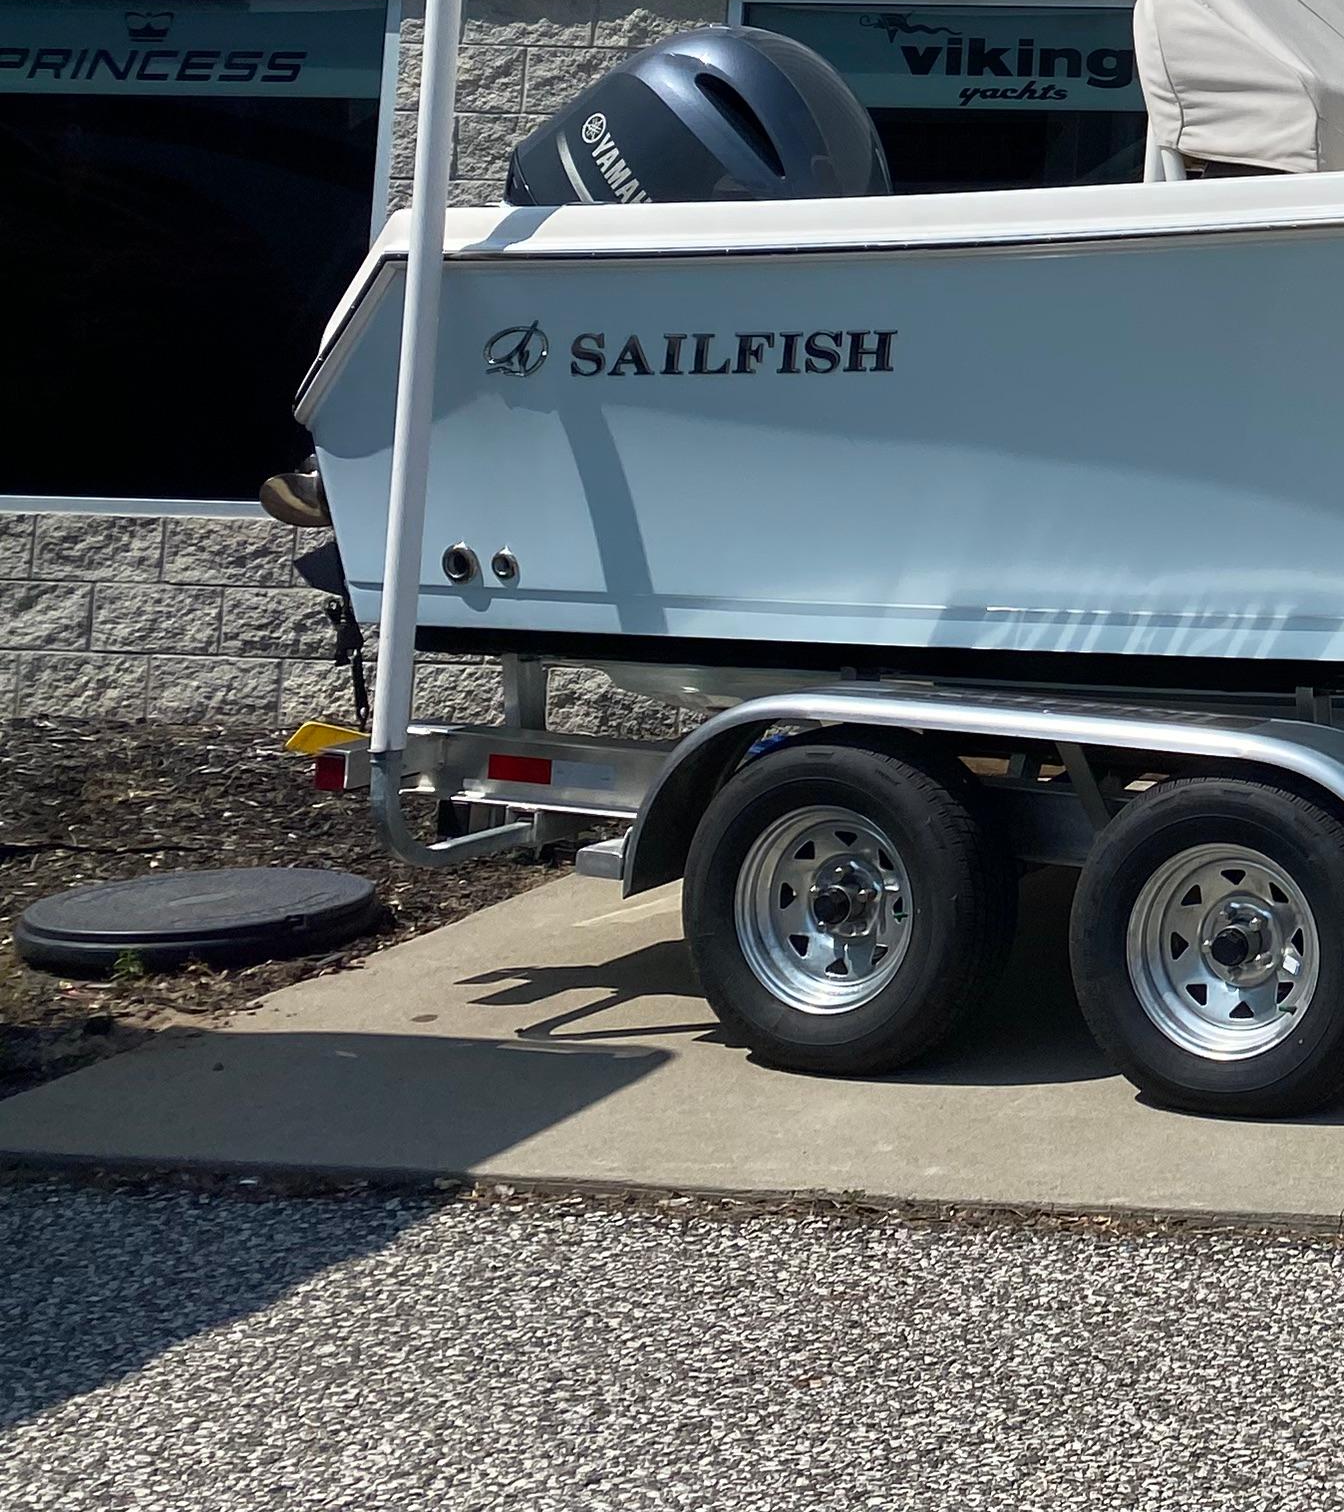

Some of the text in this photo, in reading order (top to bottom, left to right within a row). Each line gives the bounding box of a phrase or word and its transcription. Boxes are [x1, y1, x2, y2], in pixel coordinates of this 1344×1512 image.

[900, 38, 1135, 89] viking
[959, 80, 1068, 106] yachts
[570, 329, 898, 377] SAILFISH
